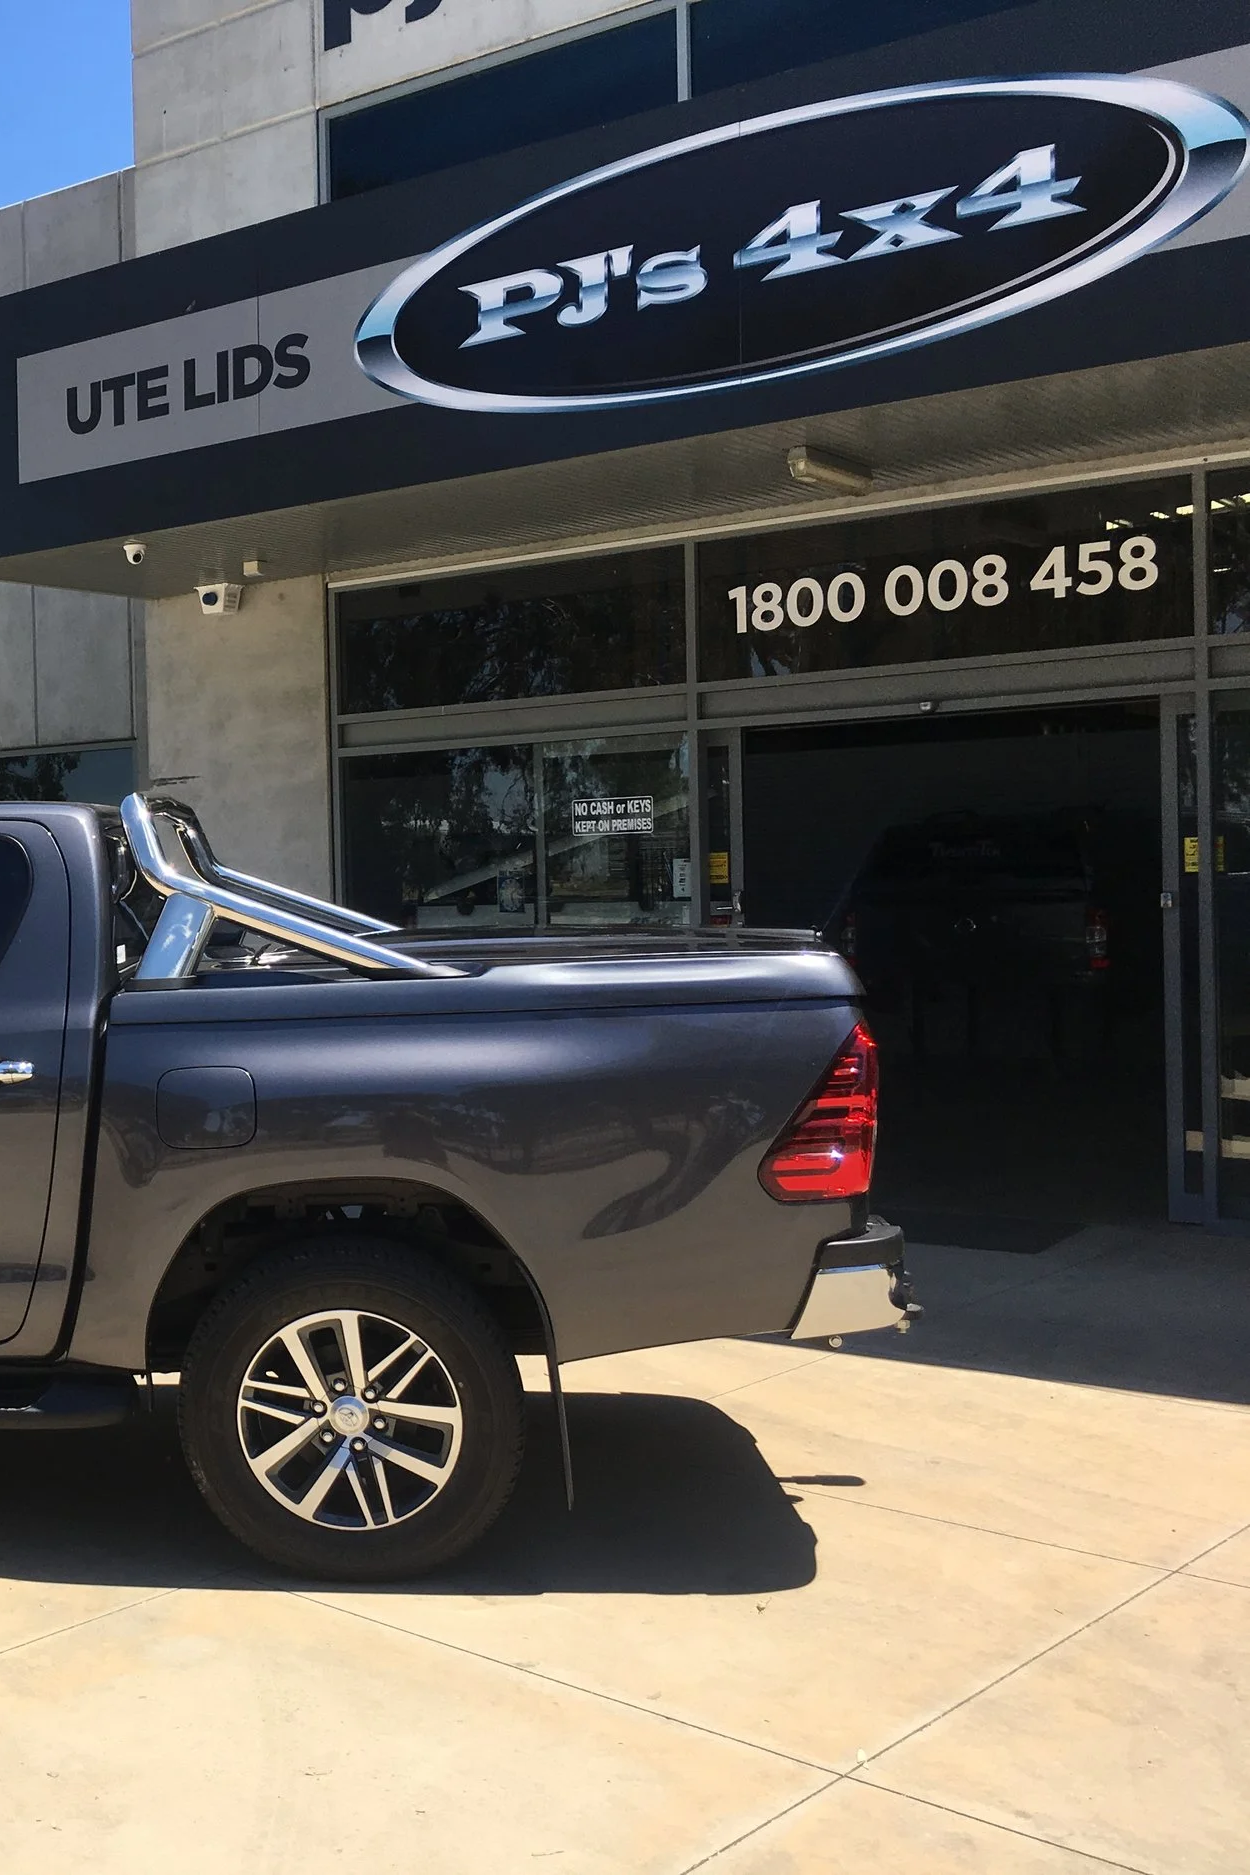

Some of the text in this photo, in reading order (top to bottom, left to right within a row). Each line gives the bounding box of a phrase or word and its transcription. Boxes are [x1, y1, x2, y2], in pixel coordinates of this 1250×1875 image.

[732, 143, 1088, 283] 4x4
[66, 332, 311, 435] UTE LIDS
[727, 535, 1159, 634] 1800 008 458
[574, 799, 652, 816] NO CASH or KEYS
[575, 817, 652, 833] KEPT ON PREMISES
